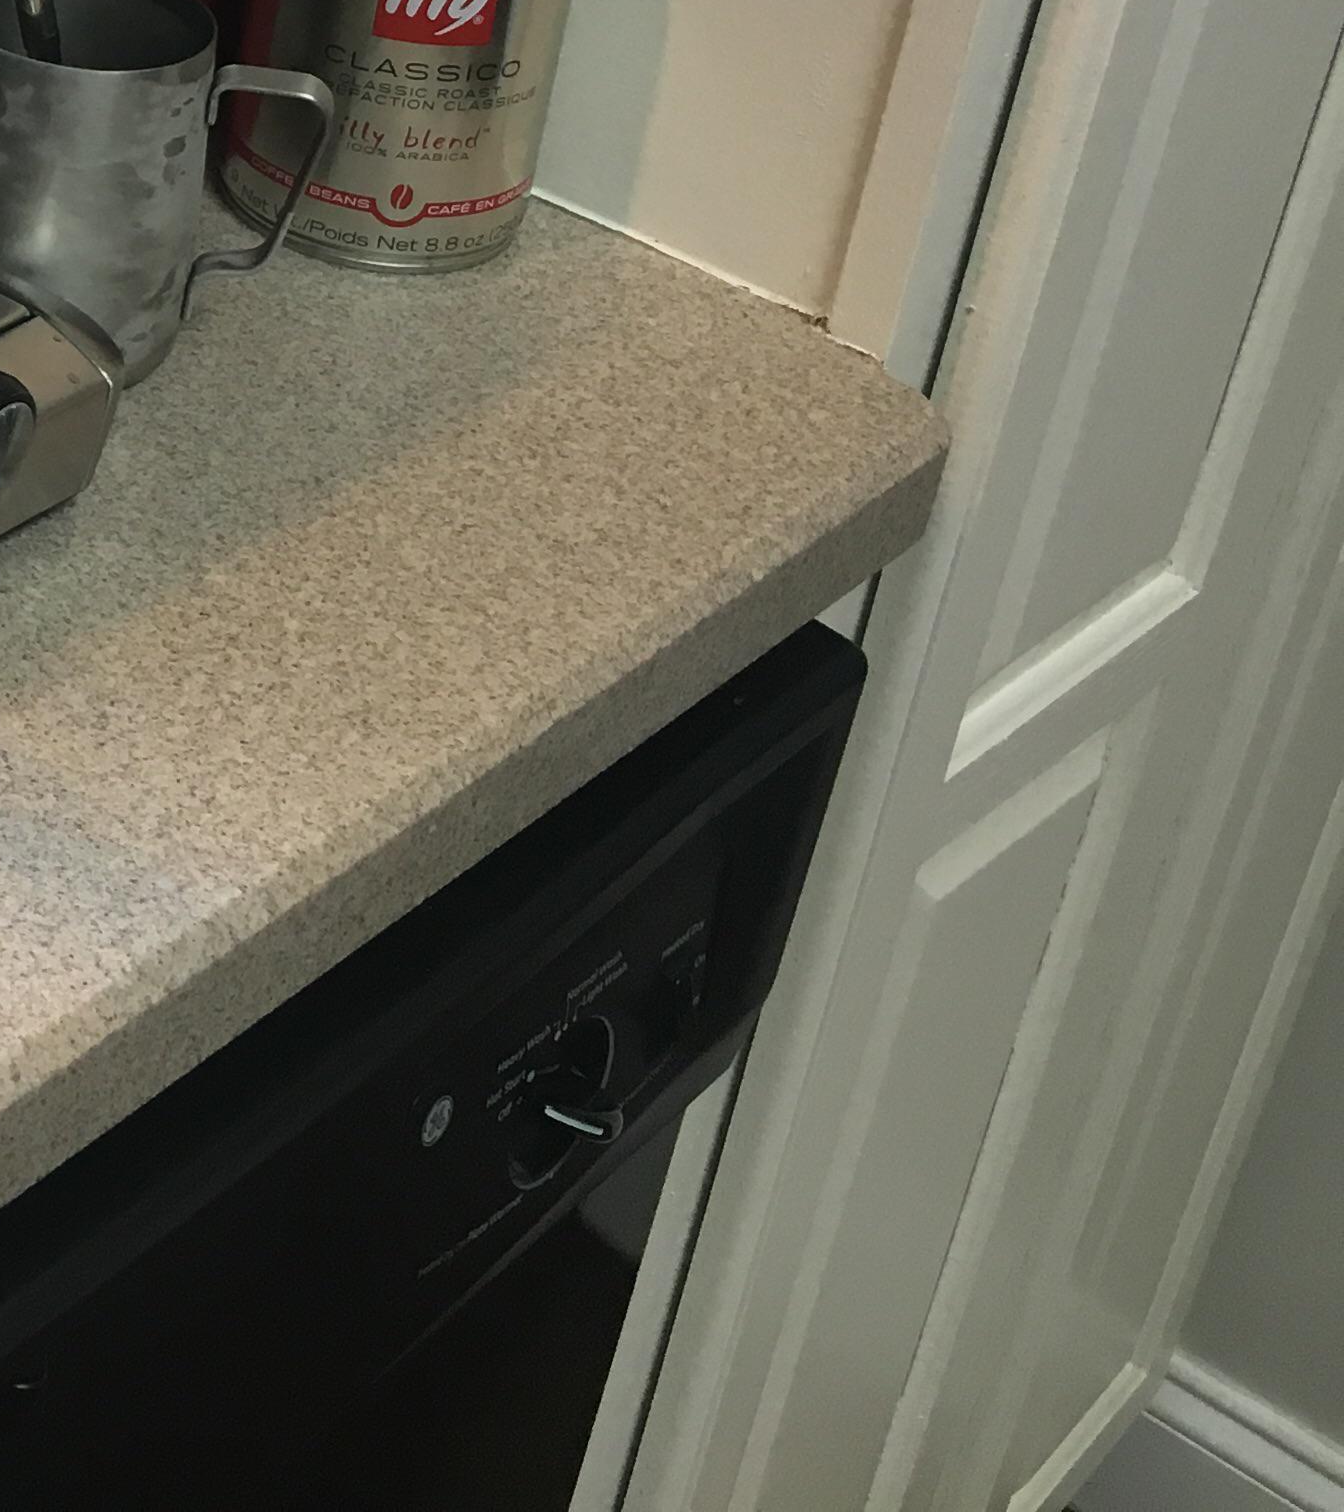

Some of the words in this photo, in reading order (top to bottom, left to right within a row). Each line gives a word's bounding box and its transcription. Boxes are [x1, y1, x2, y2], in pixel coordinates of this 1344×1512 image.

[324, 44, 521, 82] CLASSICO
[339, 72, 427, 98] CLASSIC
[436, 86, 501, 100] ROAST
[444, 86, 536, 111] CLASSIQUE
[339, 116, 385, 149] illy
[345, 141, 388, 158] 100%
[395, 150, 470, 162] ARABICA
[250, 156, 295, 187] COFFE
[309, 185, 371, 209] BEANS
[427, 202, 471, 215] CAFÉ
[475, 197, 495, 211] EN
[377, 235, 418, 252] Net
[425, 236, 458, 252] 8.8
[464, 234, 485, 248] oz
